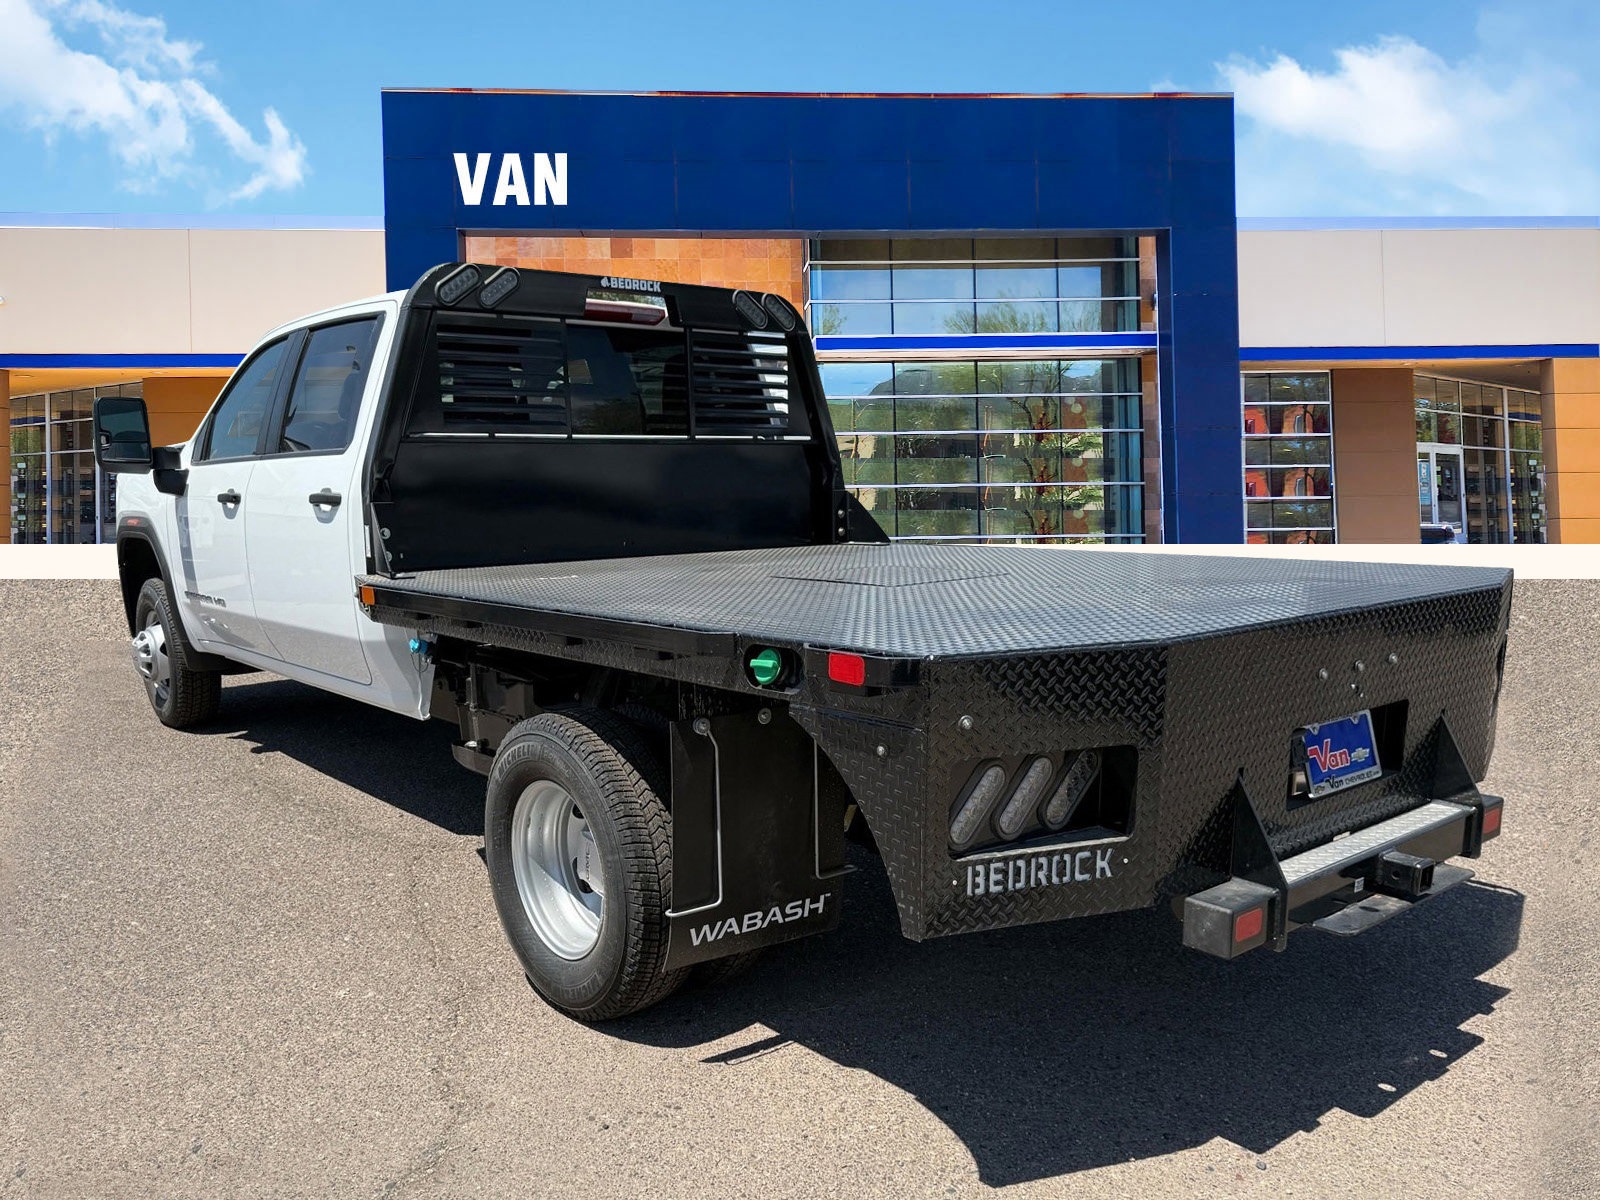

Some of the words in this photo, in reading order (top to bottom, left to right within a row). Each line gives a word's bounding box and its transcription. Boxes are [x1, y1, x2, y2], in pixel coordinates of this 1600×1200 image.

[453, 152, 568, 206] VAN
[610, 277, 662, 293] BEDROCK
[1307, 738, 1351, 773] Van
[1325, 776, 1344, 789] Van
[966, 848, 1115, 896] BEDROCK
[689, 894, 825, 946] WABASH
